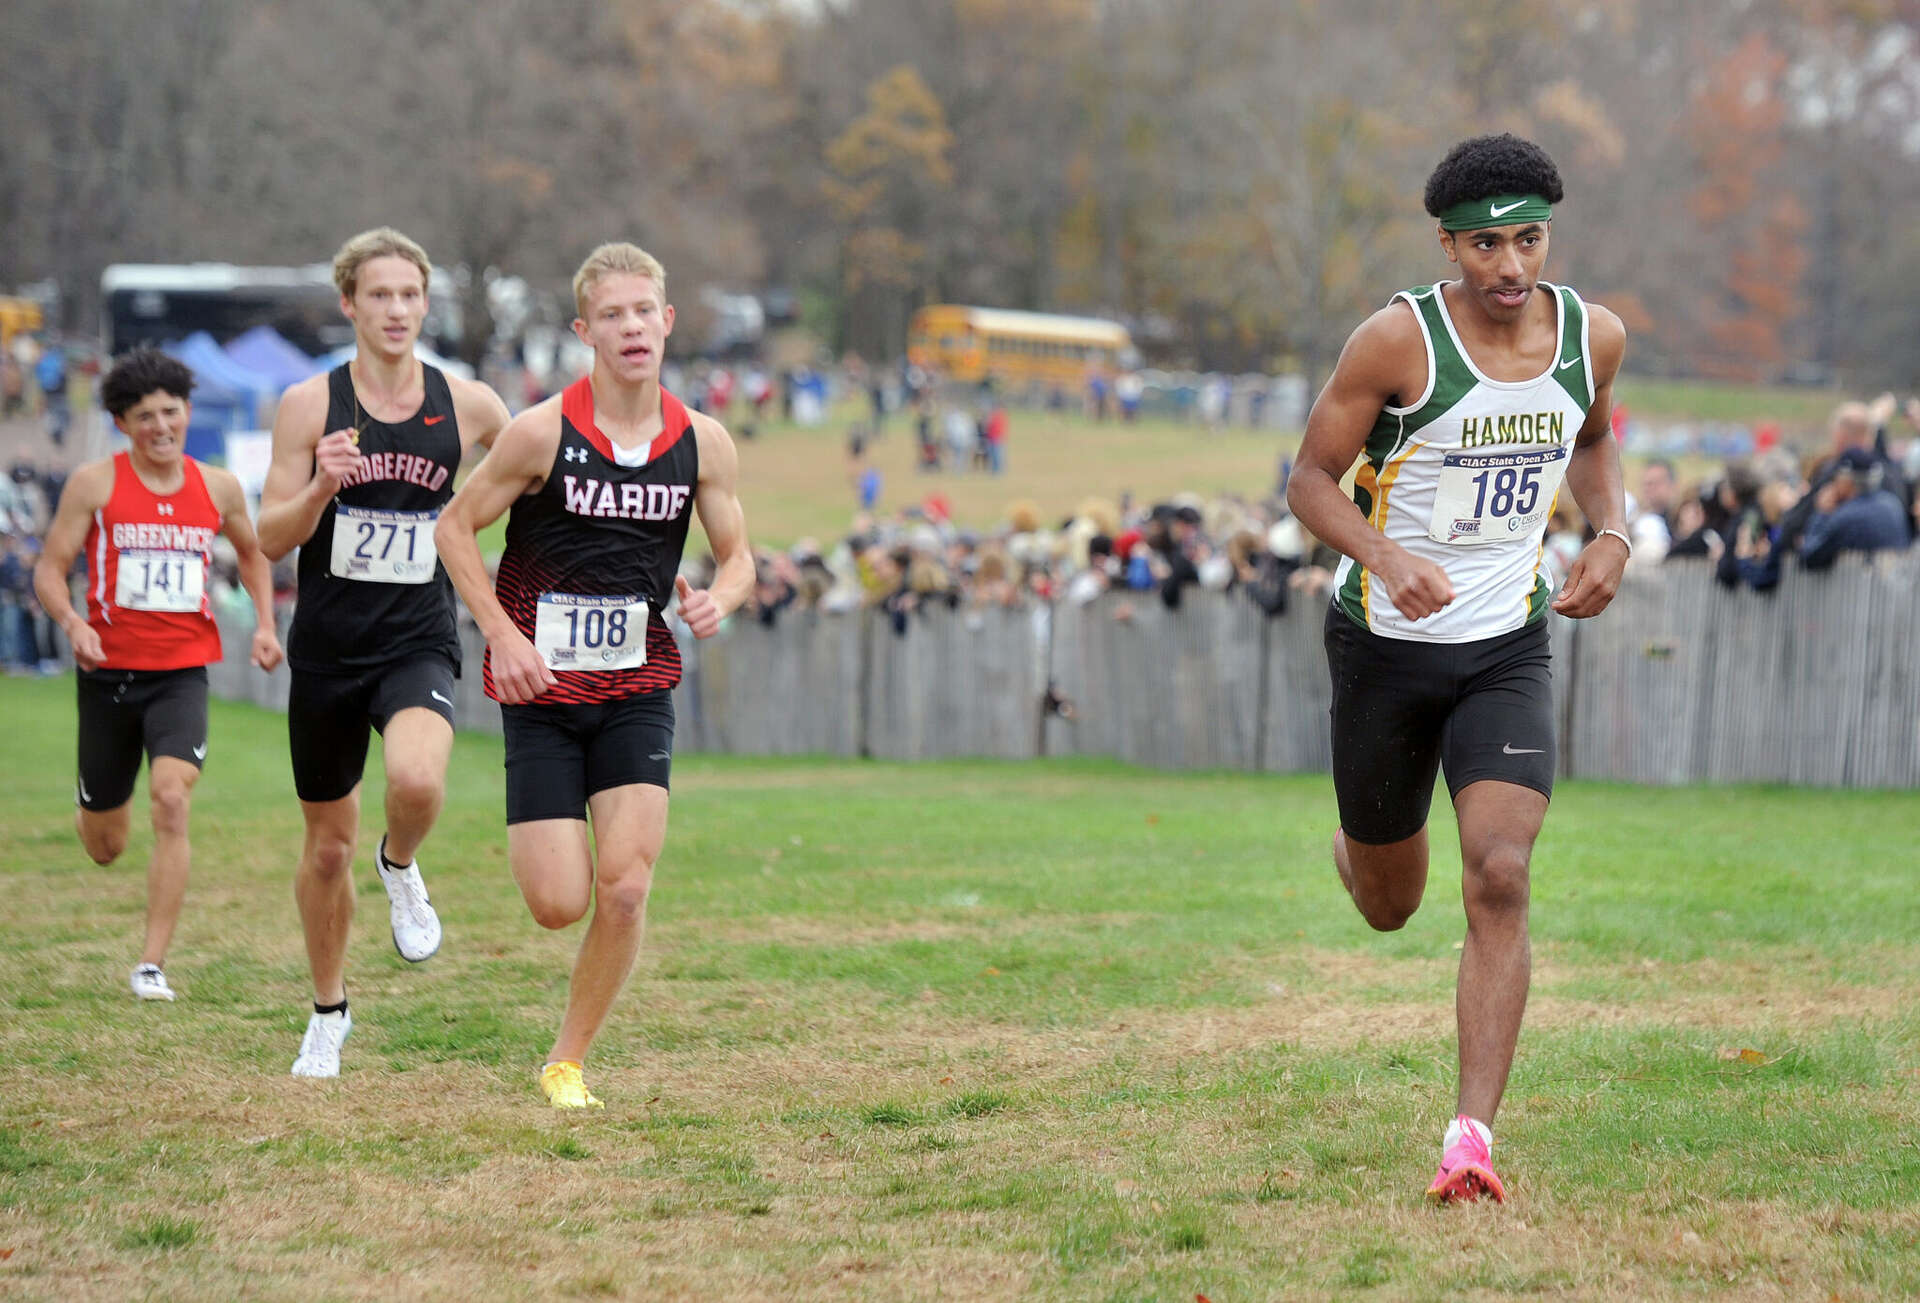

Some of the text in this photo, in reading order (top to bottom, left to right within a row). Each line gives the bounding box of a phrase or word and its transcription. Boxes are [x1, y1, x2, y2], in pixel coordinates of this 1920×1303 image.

[1461, 412, 1563, 448] HAMDEN
[1459, 451, 1557, 468] CIAC State Open XC
[563, 474, 691, 522] WARDE
[1472, 466, 1543, 518] 185
[355, 522, 416, 561] 271
[140, 560, 184, 593] 141
[564, 608, 627, 648] 108
